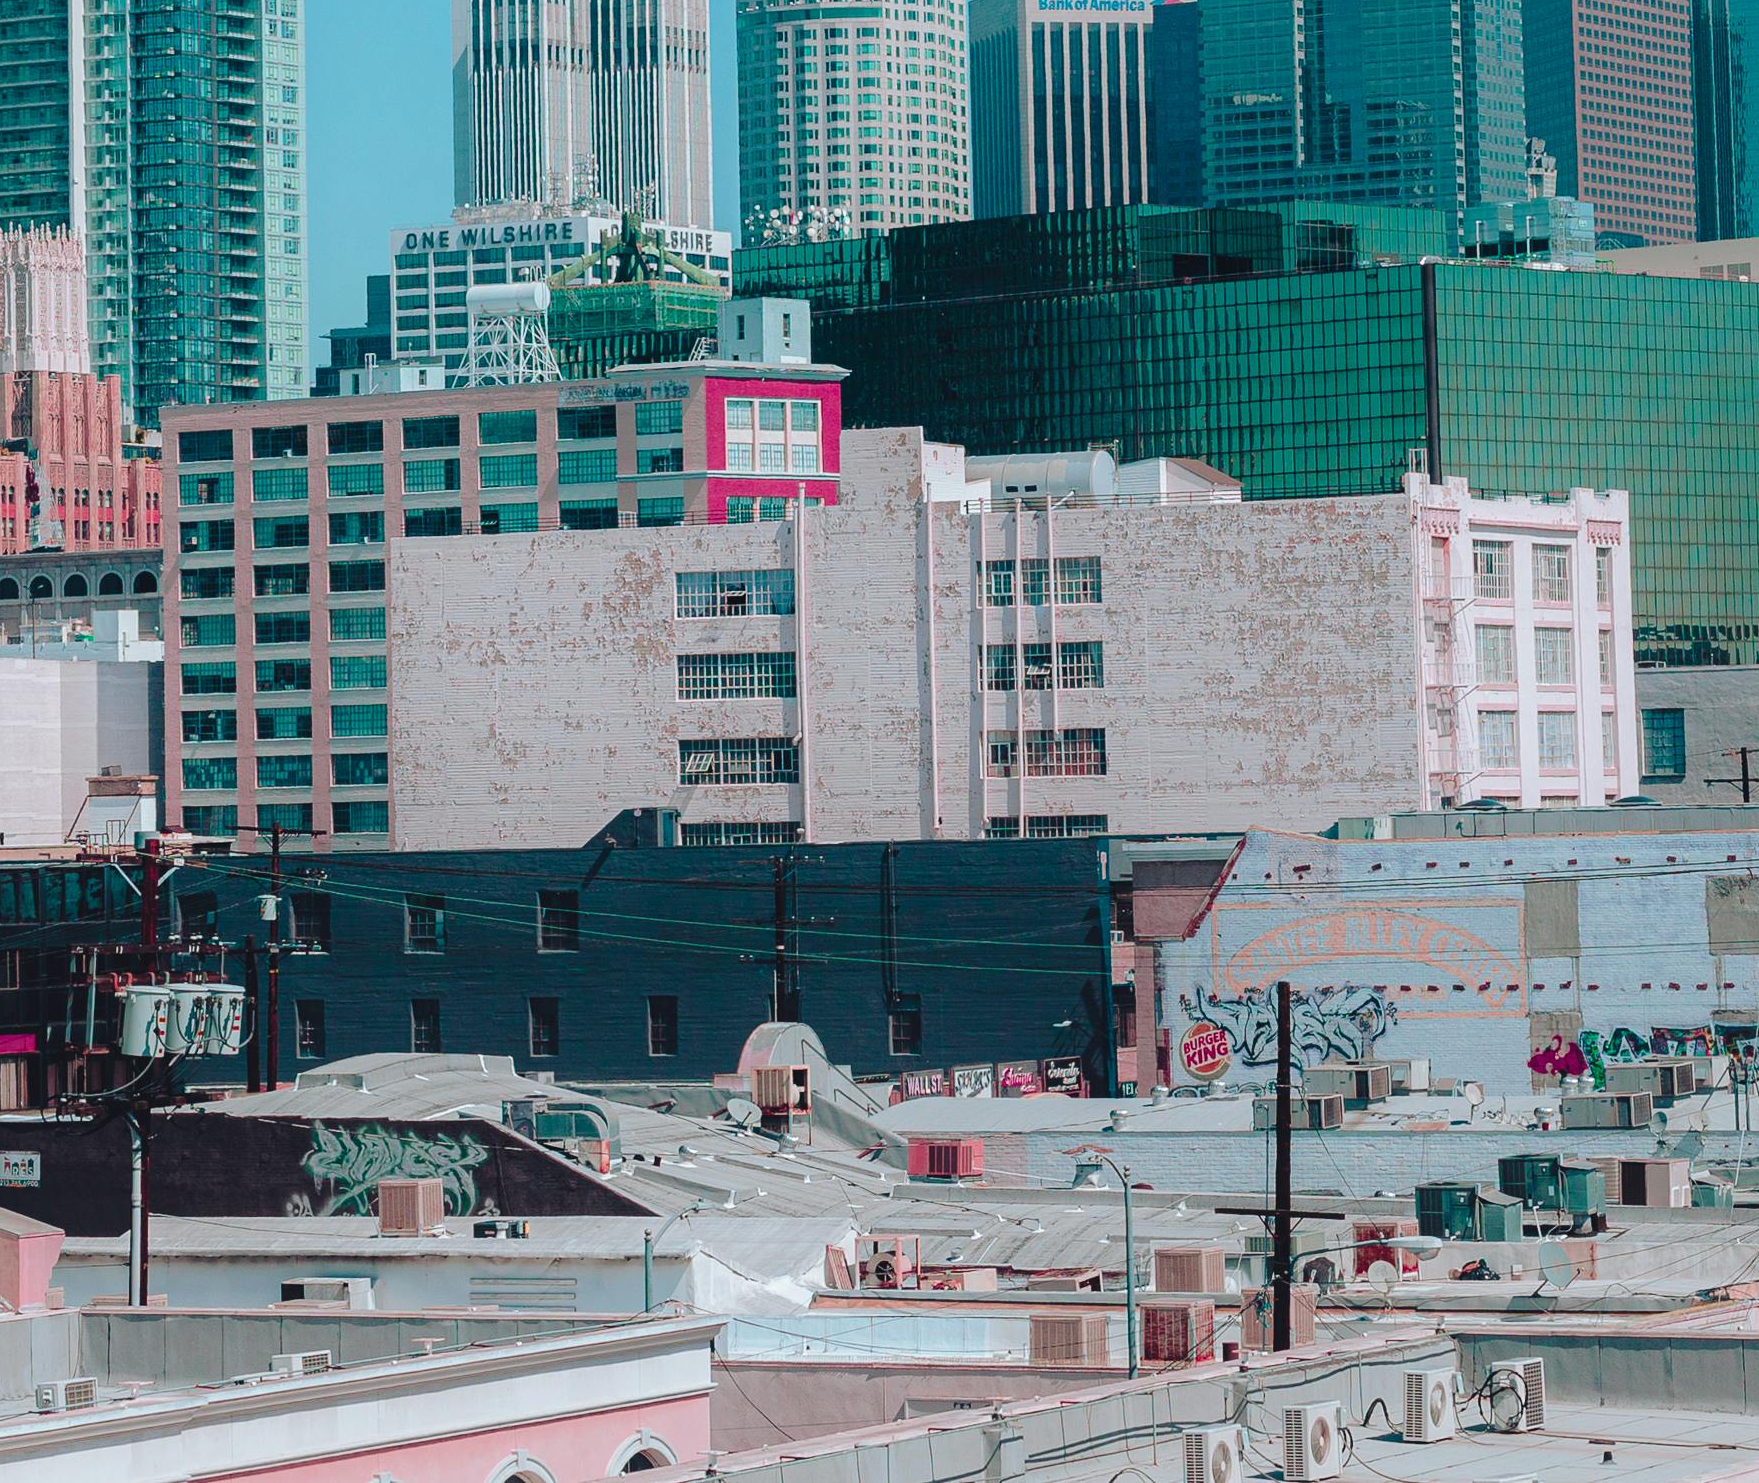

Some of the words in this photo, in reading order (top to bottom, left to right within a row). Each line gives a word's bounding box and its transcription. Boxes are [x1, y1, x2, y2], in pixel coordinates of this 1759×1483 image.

[405, 230, 450, 250] ONE
[461, 222, 573, 246] WILSHIRE
[1183, 1030, 1227, 1055] BURGER
[1186, 1042, 1229, 1068] KING
